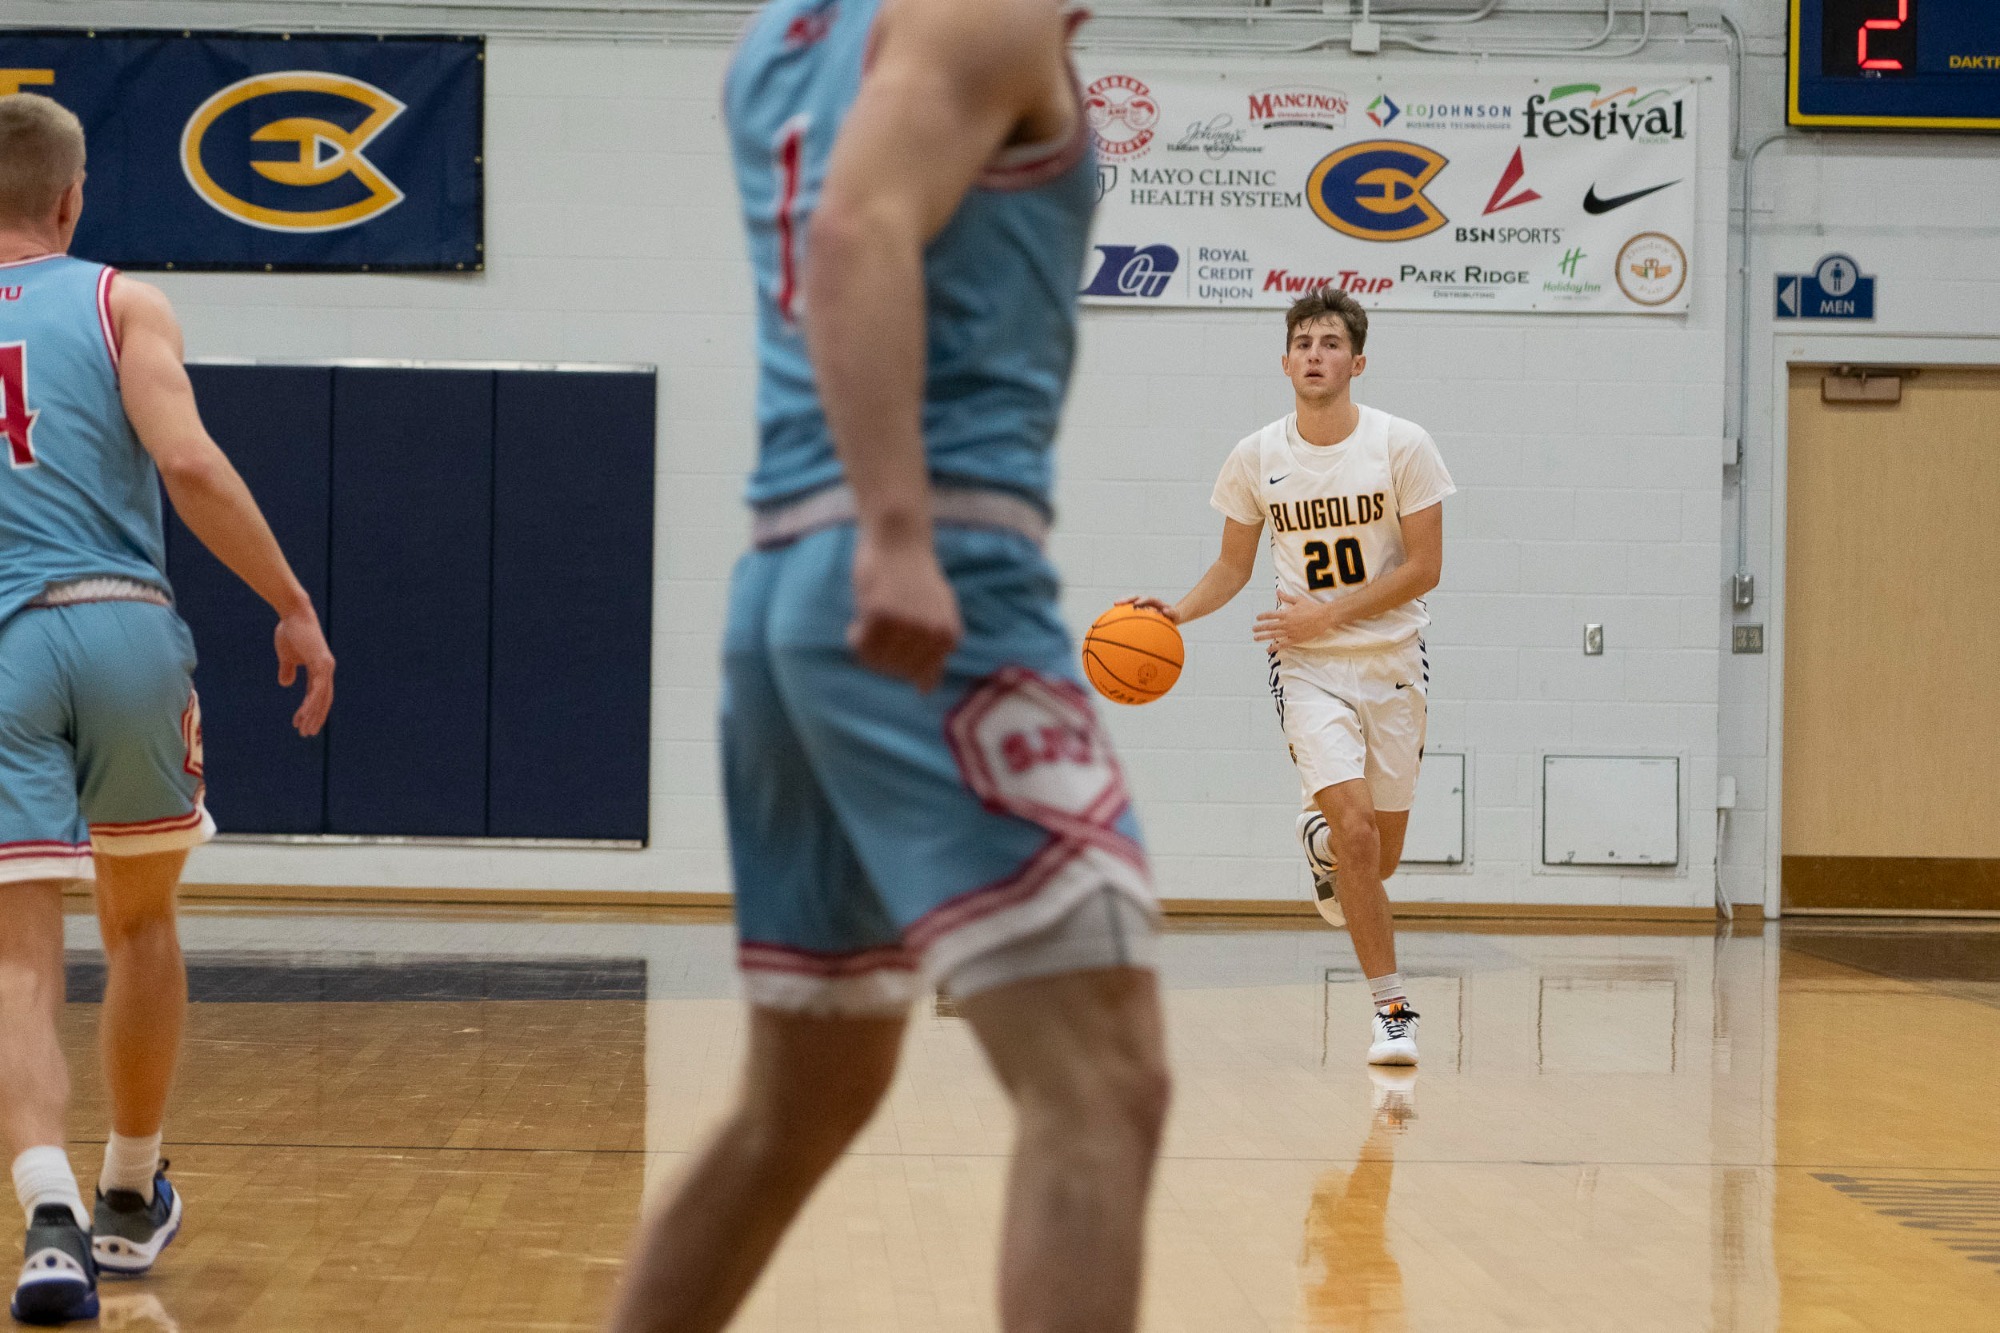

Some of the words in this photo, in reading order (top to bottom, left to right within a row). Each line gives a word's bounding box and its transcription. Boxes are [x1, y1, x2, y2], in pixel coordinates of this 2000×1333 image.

[1857, 0, 1908, 70] 2
[1248, 93, 1348, 121] MANCINO'S
[1522, 94, 1686, 140] festival
[1130, 168, 1193, 184] MAYO
[1199, 168, 1277, 186] CLINIC
[1130, 189, 1214, 206] HEALTH
[1220, 190, 1302, 208] SYSTEM
[1455, 228, 1495, 243] BSN
[1498, 228, 1561, 244] SPORTS
[1198, 247, 1250, 263] ROYAL
[1198, 265, 1254, 281] CREDIT
[1338, 269, 1394, 293] TRIP
[1400, 265, 1457, 283] PARK
[1464, 265, 1530, 285] RIDGE
[1198, 284, 1254, 299] UNION
[1819, 300, 1855, 314] MEN
[1269, 493, 1385, 533] BLUGOLDS
[1303, 535, 1367, 592] 20
